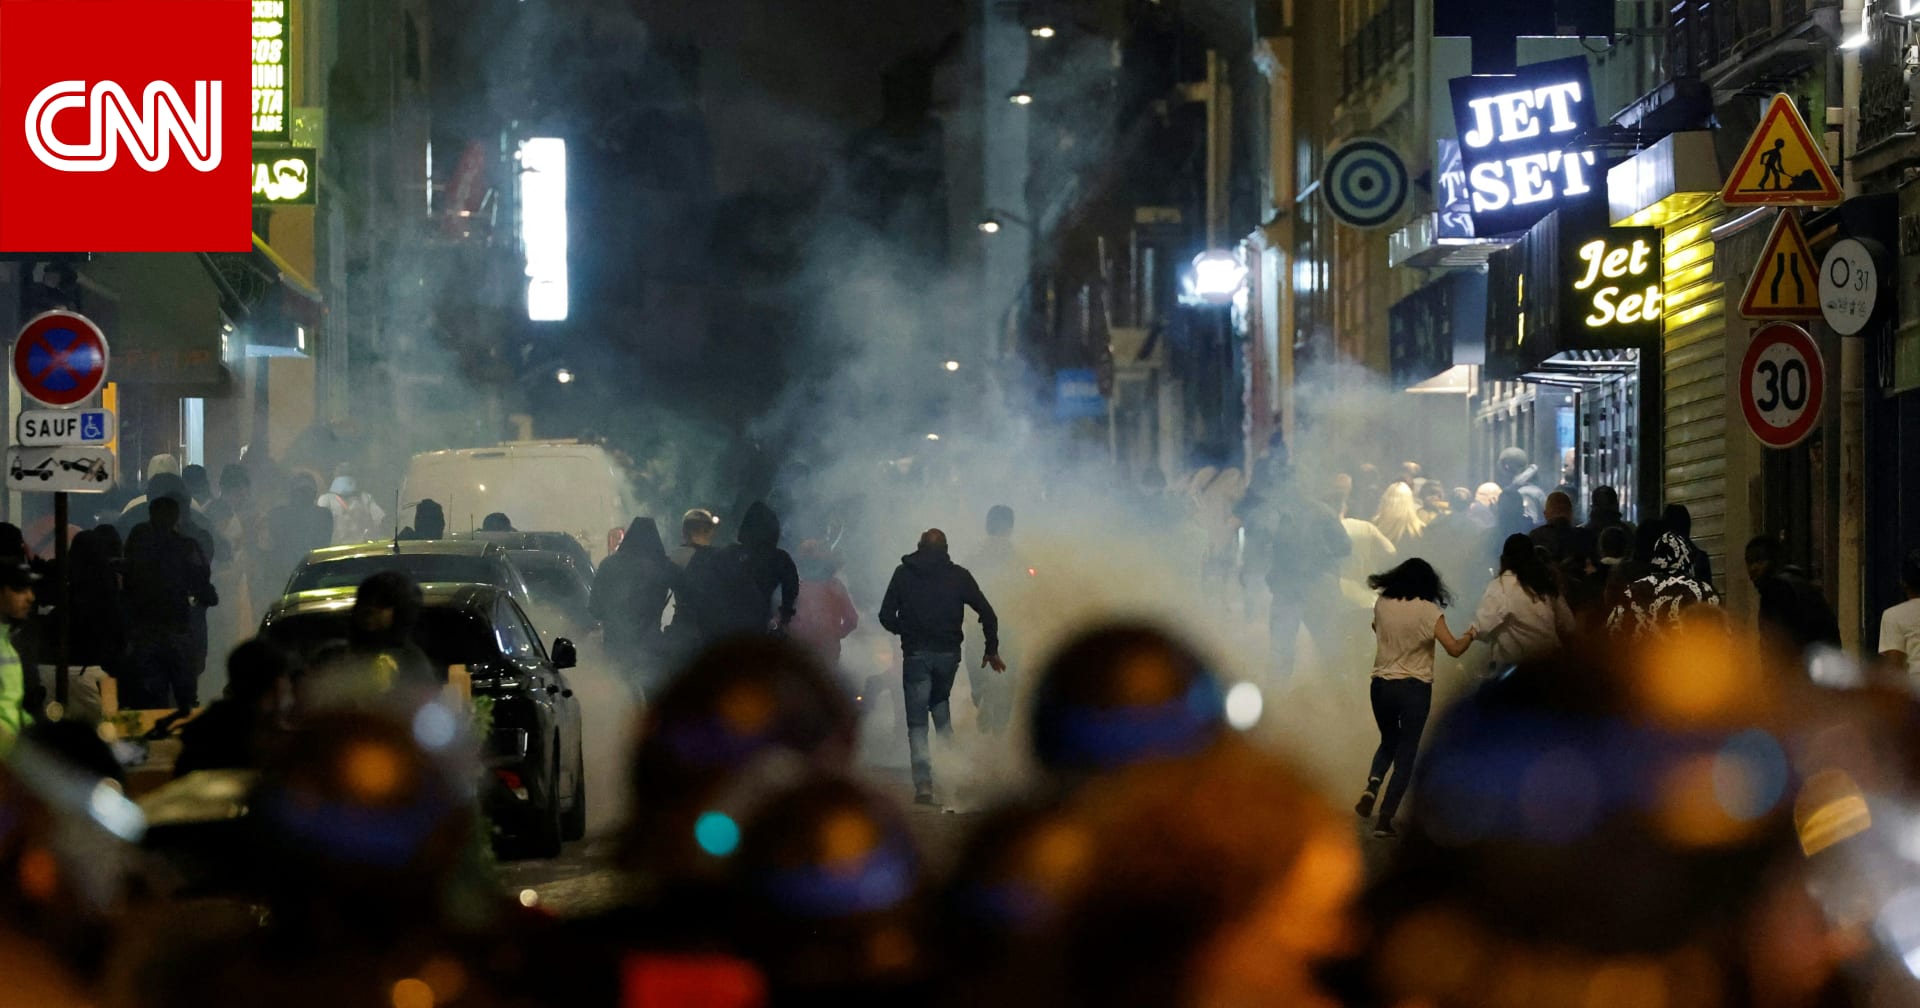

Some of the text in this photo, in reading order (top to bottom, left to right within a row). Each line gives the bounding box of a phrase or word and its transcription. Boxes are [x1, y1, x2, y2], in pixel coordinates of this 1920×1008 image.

[1468, 81, 1582, 148] JET
[1470, 150, 1595, 213] SET
[1574, 239, 1651, 290] Jet
[1585, 286, 1663, 327] Set
[1757, 358, 1807, 412] 30
[25, 418, 77, 438] SAUF
